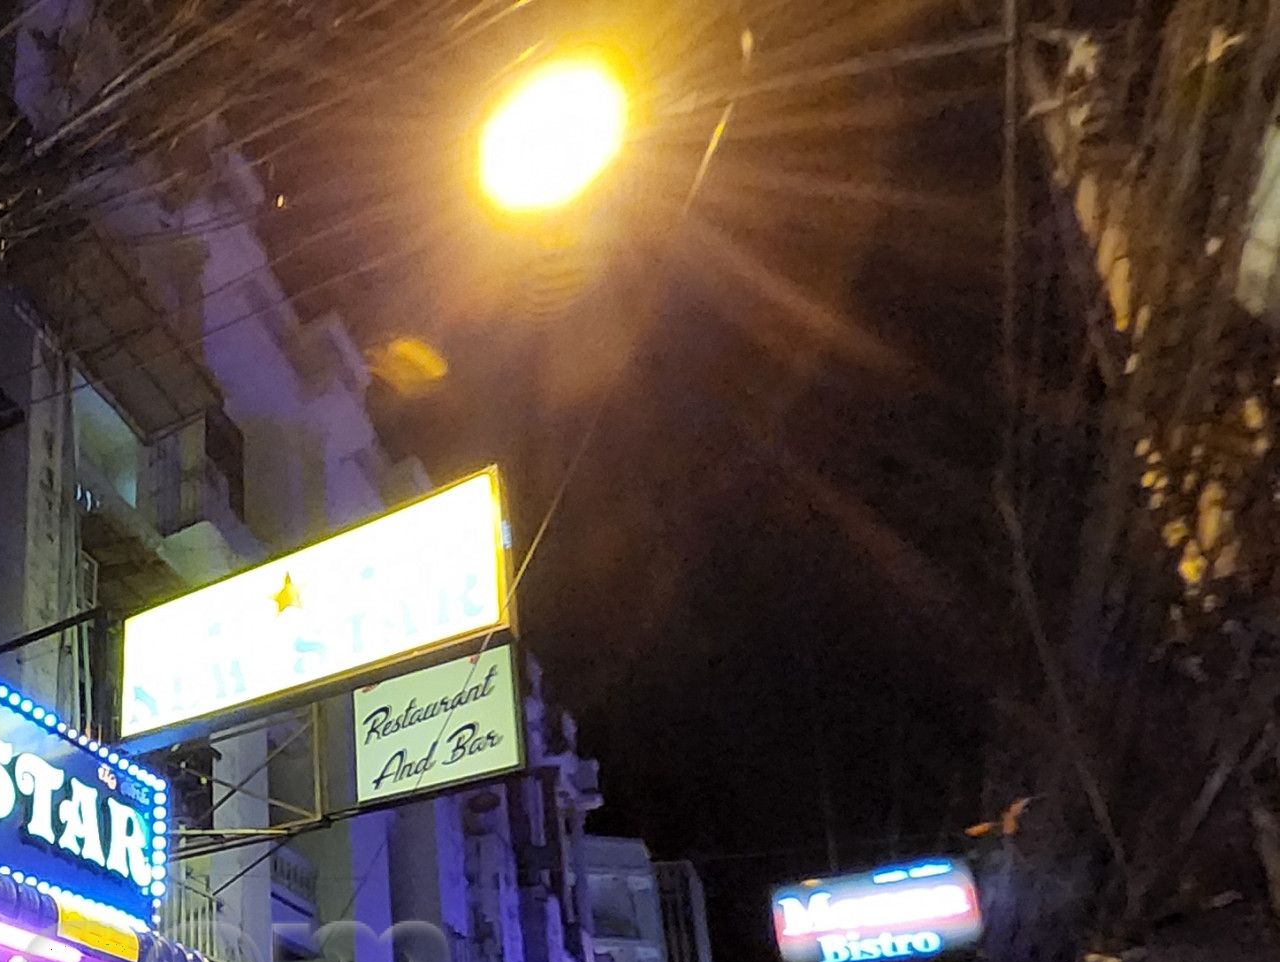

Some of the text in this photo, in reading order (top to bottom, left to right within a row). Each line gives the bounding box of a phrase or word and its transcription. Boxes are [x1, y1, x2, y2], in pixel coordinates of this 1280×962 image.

[363, 664, 498, 745] Restaurant
[372, 721, 504, 790] And Bar
